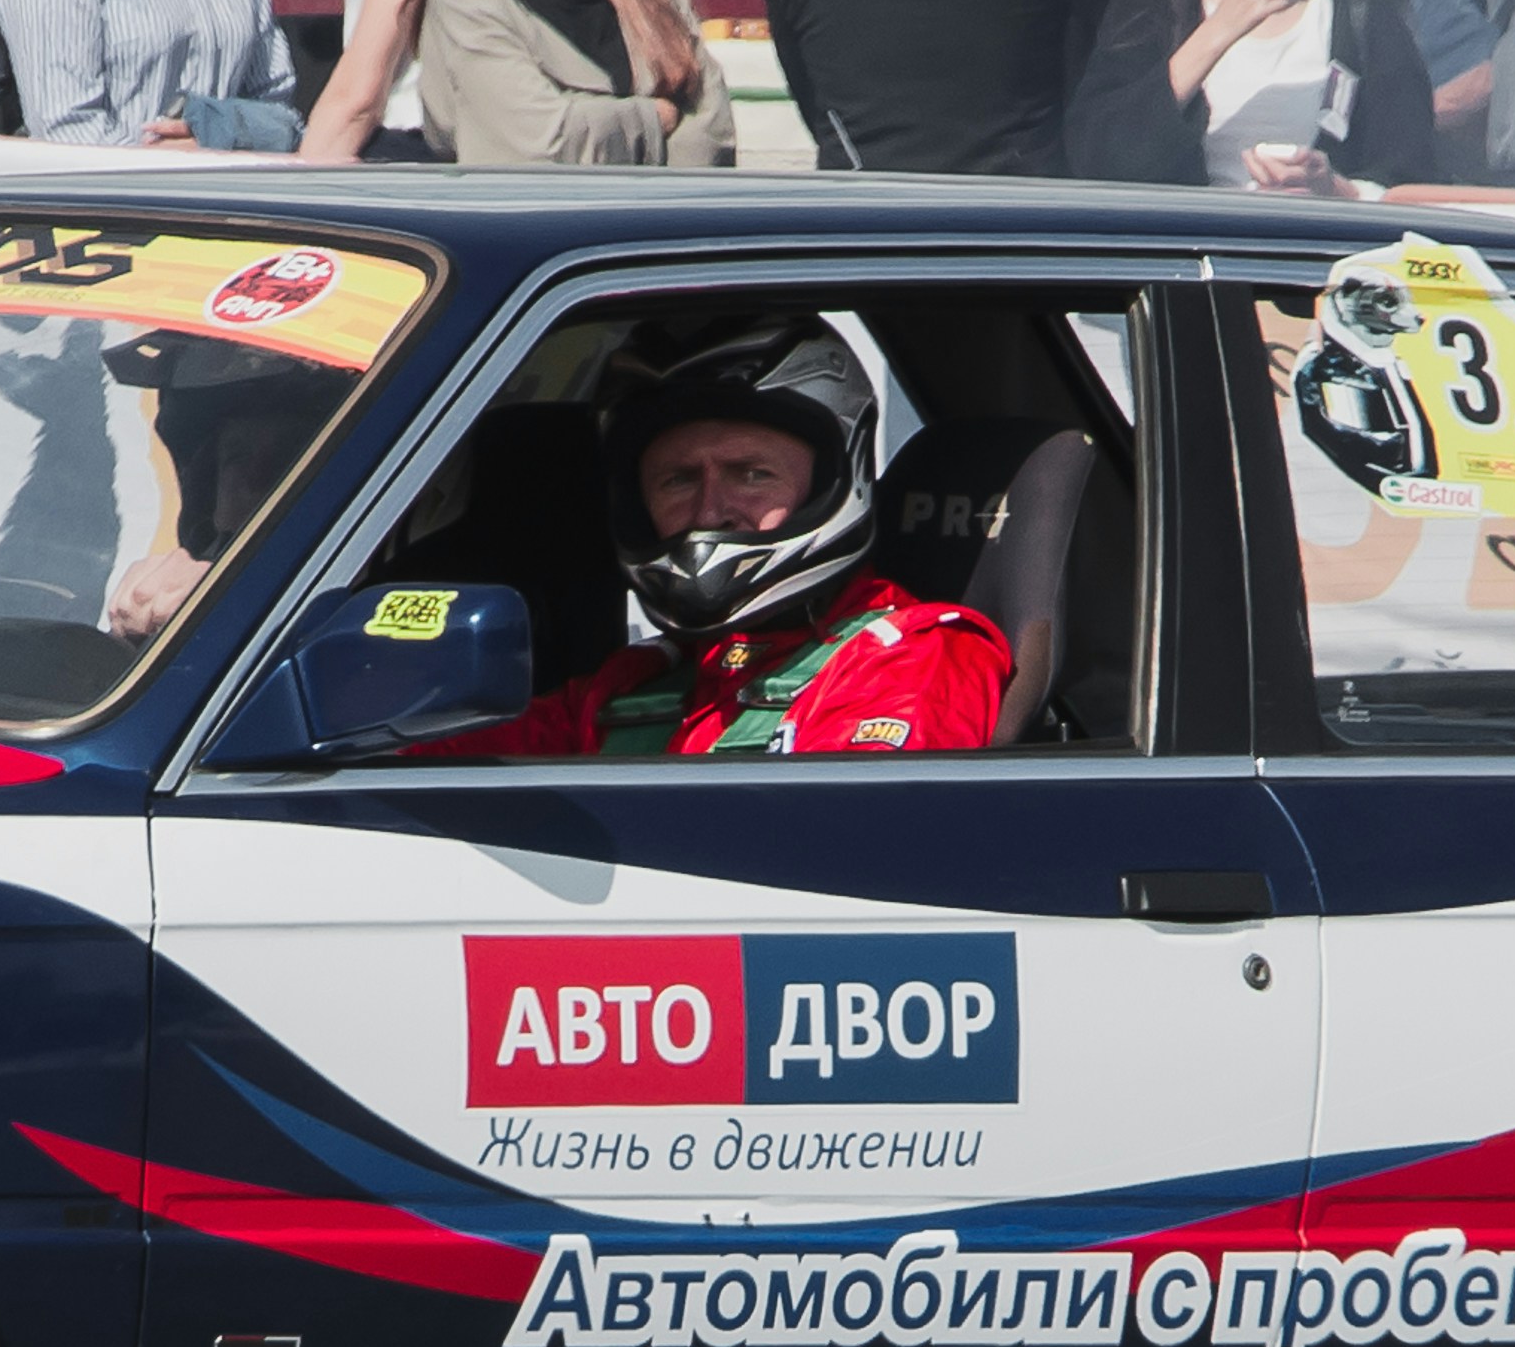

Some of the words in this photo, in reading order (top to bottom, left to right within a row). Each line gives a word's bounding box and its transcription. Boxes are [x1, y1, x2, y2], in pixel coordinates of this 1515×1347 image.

[266, 253, 332, 282] 18+
[1438, 318, 1501, 426] 3
[1407, 482, 1474, 508] Castrol
[496, 984, 712, 1067] АВТО
[769, 981, 995, 1080] ДВОР
[477, 1116, 650, 1171] Жизнь
[668, 1133, 696, 1171] в
[713, 1117, 983, 1172] движении
[521, 1243, 1122, 1337] Автомобили
[1145, 1261, 1203, 1336] с
